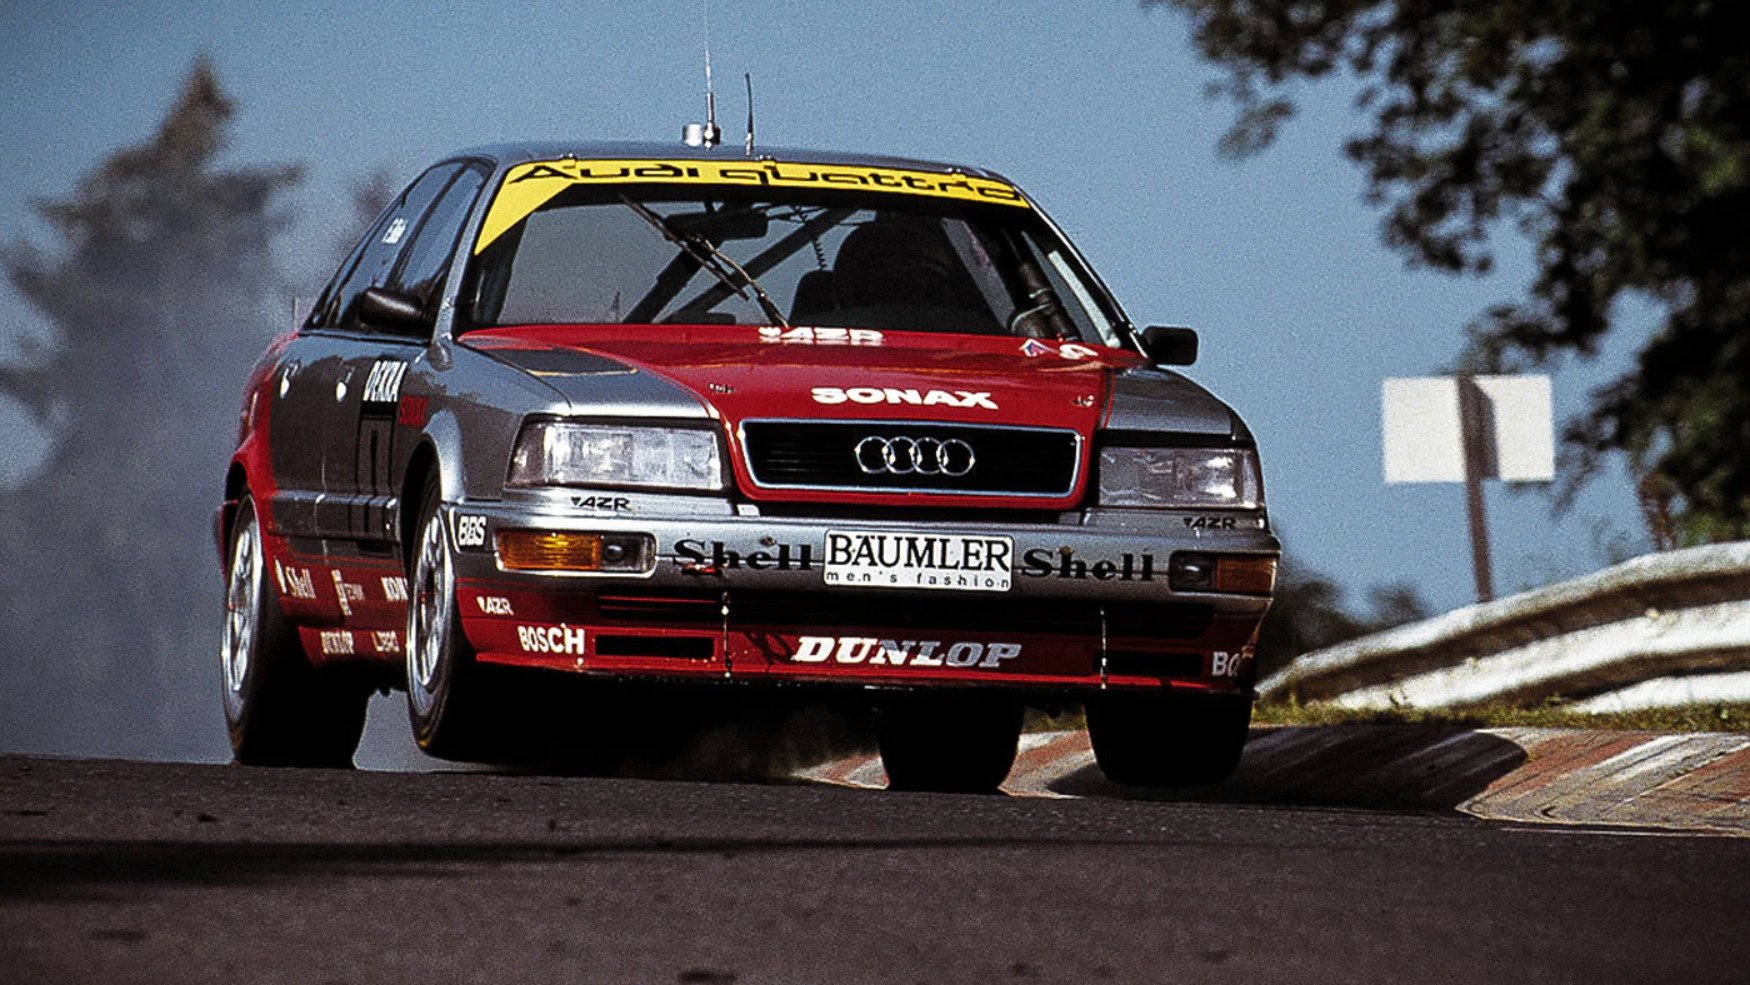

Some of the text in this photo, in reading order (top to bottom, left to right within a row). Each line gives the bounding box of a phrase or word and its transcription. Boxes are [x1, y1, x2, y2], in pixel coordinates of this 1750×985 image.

[719, 165, 1022, 201] quattro
[779, 326, 884, 345] AZR
[811, 387, 999, 410] SONAX
[577, 496, 632, 511] AZR
[458, 515, 487, 547] BBS
[1191, 517, 1237, 530] AZR
[673, 538, 813, 571] Shell
[827, 533, 1013, 572] BÄUMLER
[1021, 548, 1154, 582] Shell
[916, 573, 1010, 590] fashion
[485, 597, 514, 616] AZR
[517, 625, 586, 655] BOSCH
[790, 636, 1023, 668] DUNLOP
